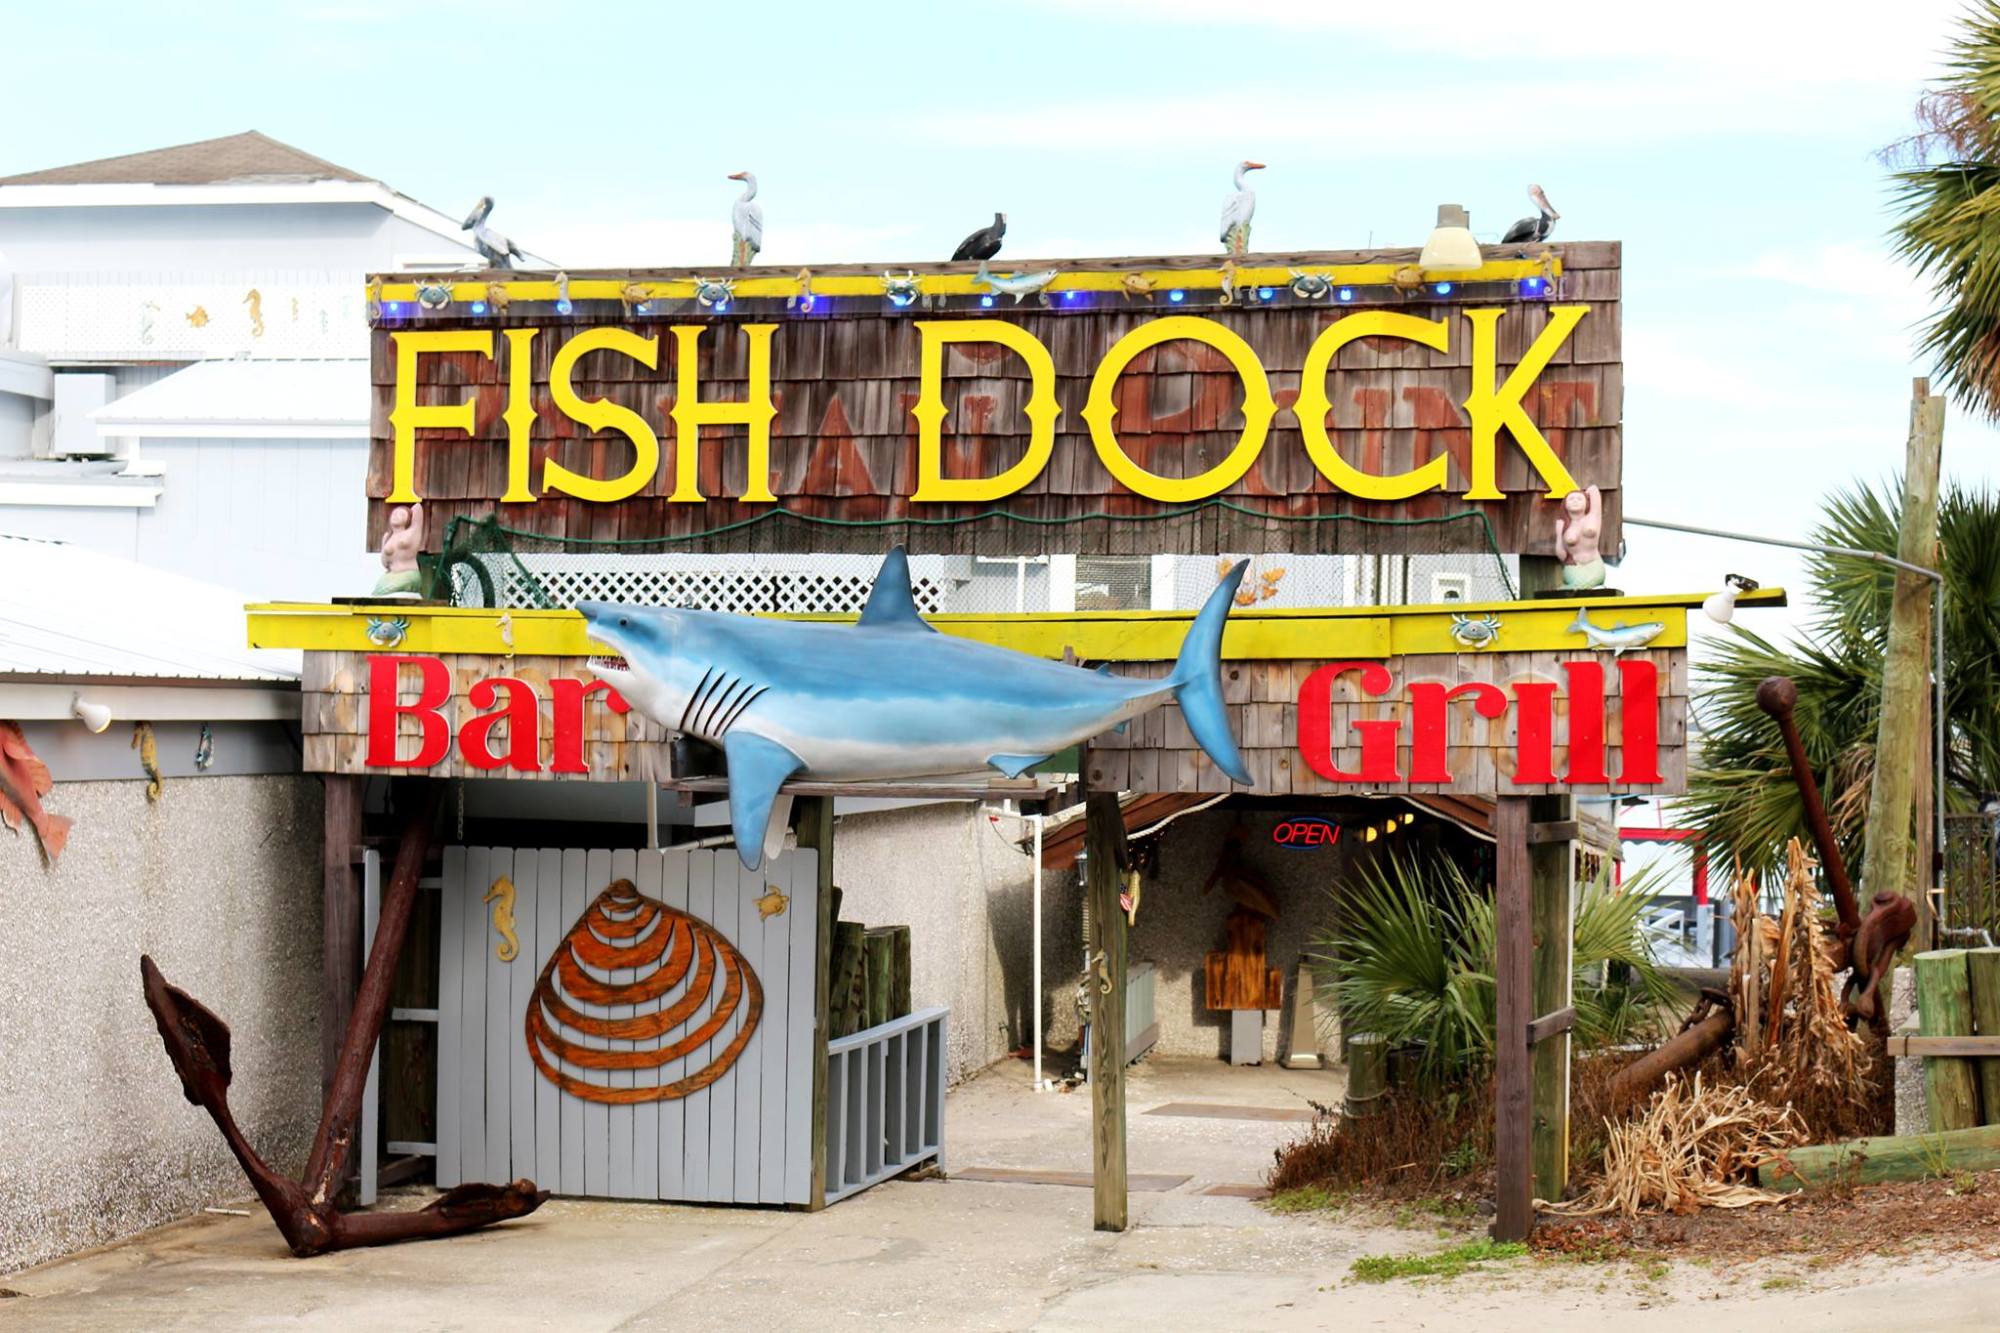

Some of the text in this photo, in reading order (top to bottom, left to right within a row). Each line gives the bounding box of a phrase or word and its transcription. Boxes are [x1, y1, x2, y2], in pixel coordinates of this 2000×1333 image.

[386, 322, 779, 504] FISH
[908, 304, 1592, 504] DOCK
[364, 655, 1665, 785] Bar Grill
[1272, 821, 1341, 845] OPEN
